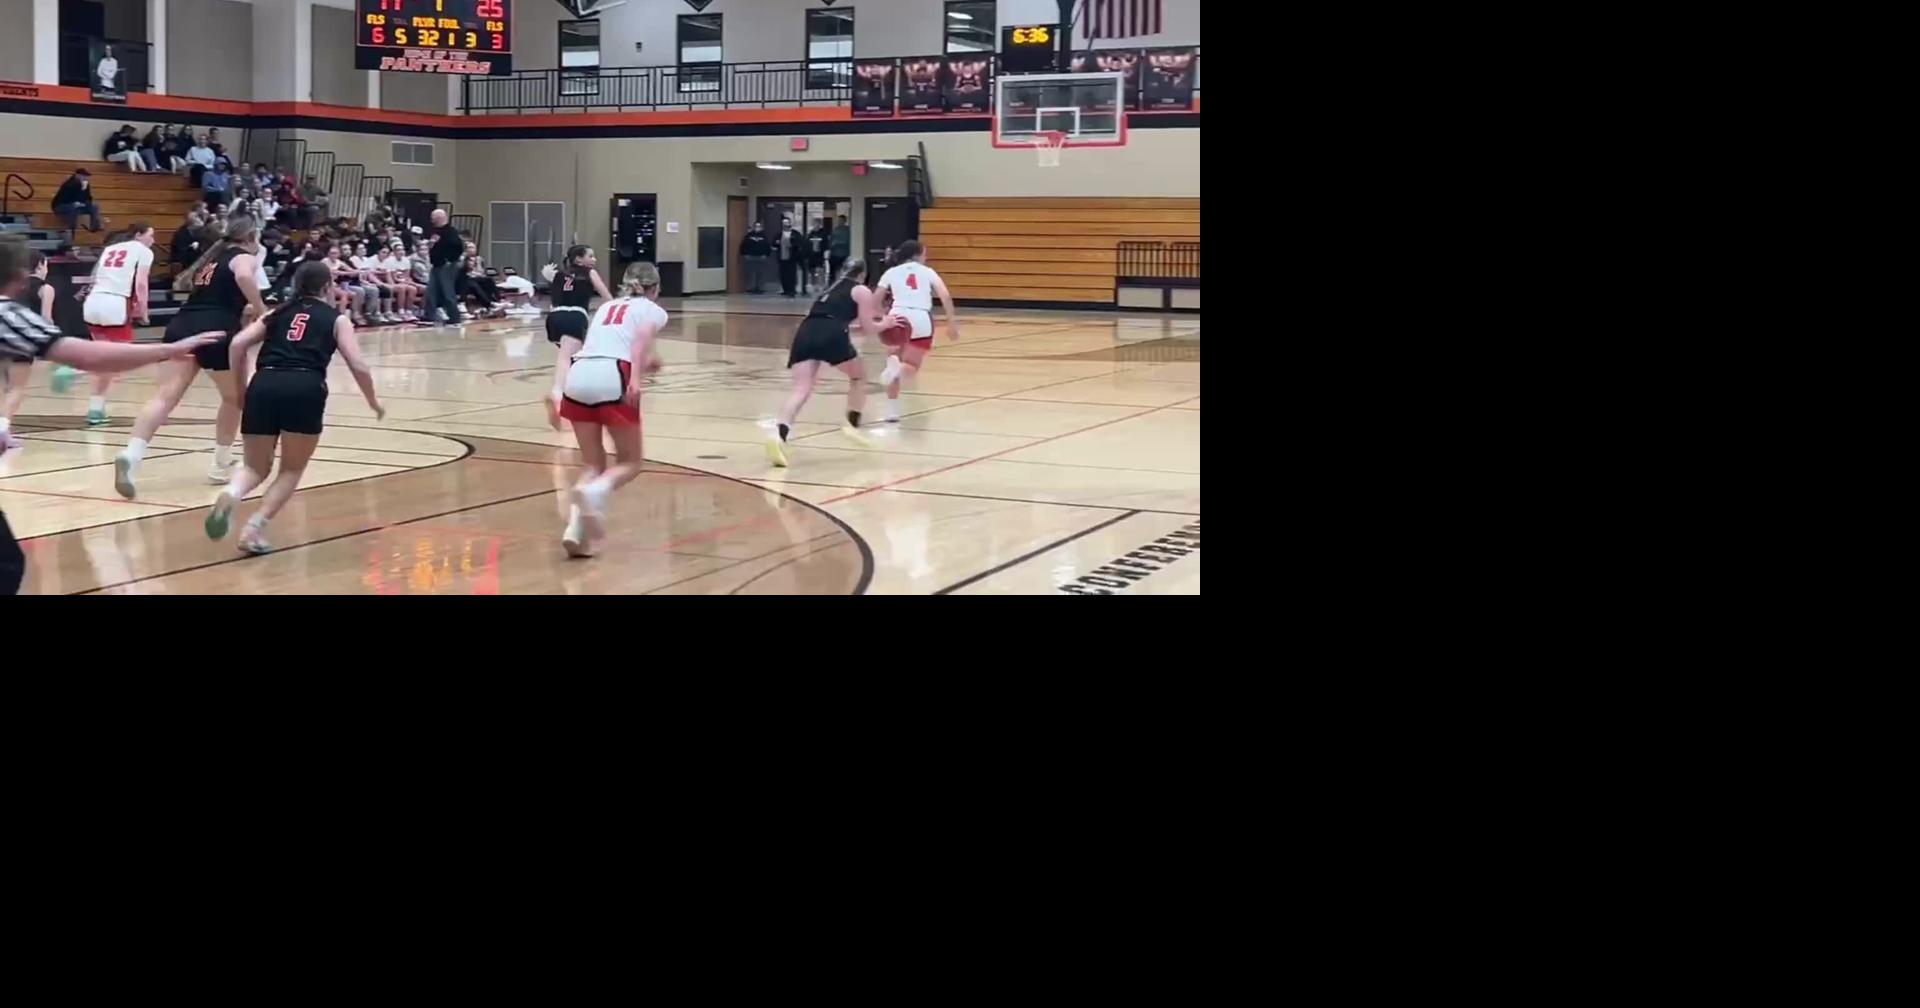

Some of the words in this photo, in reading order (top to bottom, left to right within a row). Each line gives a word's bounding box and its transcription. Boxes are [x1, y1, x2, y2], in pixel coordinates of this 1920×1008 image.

[477, 0, 503, 17] 25
[367, 14, 385, 24] FLS
[487, 21, 504, 31] FLS
[373, 28, 385, 43] 6
[418, 29, 440, 46] 32
[449, 33, 455, 45] 1
[465, 32, 477, 48] 3
[491, 33, 503, 49] 3
[379, 57, 492, 74] PANTHERS
[103, 249, 128, 268] 22
[563, 275, 574, 291] 2
[905, 273, 918, 290] 4
[602, 304, 629, 326] 11
[287, 313, 310, 341] 5
